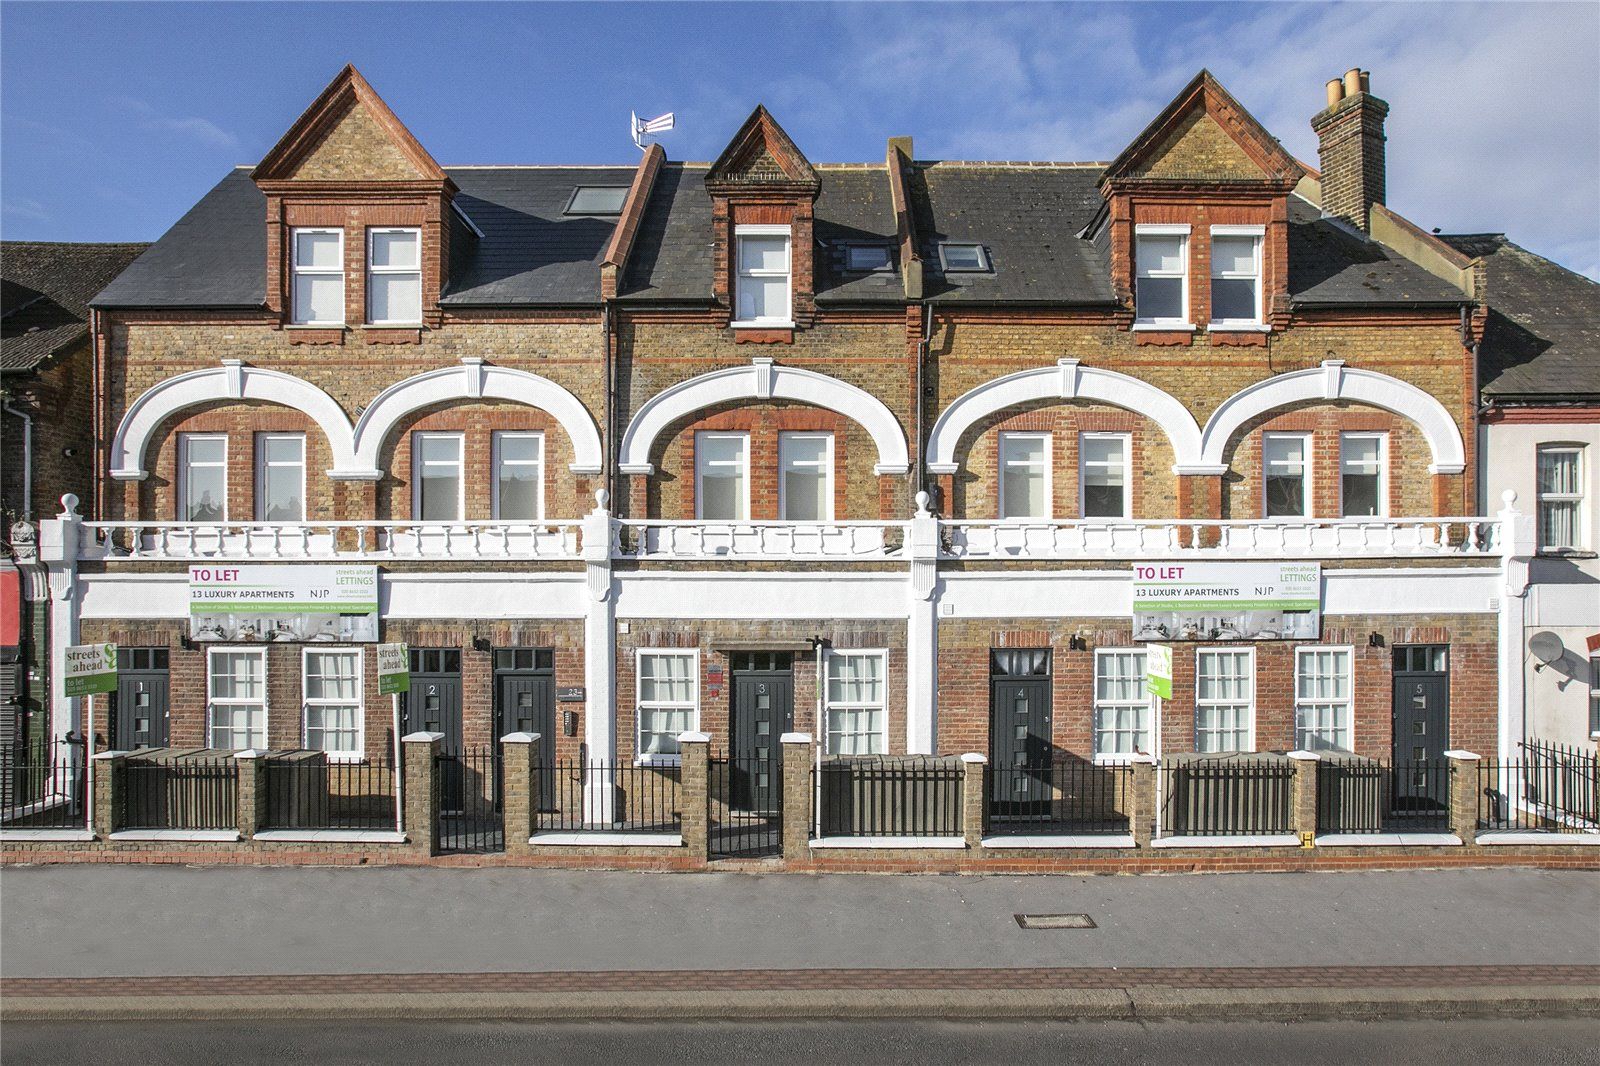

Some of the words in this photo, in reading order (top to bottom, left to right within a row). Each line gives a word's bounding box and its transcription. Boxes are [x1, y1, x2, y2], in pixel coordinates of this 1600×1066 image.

[192, 569, 211, 582] TO
[215, 569, 239, 582] LET
[1137, 567, 1155, 580] TO
[1160, 567, 1184, 579] LET
[1280, 574, 1317, 582] LETTINGS
[336, 577, 374, 585] LETTINGS
[204, 590, 237, 598] LUXURY
[239, 590, 295, 598] APARTMENTS
[310, 589, 330, 598] NJP
[1136, 589, 1146, 597] 13
[1149, 588, 1182, 597] LUXURY
[1184, 588, 1239, 597] APARTMENTS
[1255, 586, 1274, 595] NJP
[67, 650, 100, 661] streets
[380, 649, 399, 658] streets
[73, 660, 103, 672] ahead
[383, 659, 401, 670] ahead
[139, 682, 143, 691] 1
[429, 685, 436, 695] 2
[759, 683, 766, 693] 3
[1416, 683, 1423, 694] 5
[1017, 688, 1024, 698] 4
[1303, 833, 1312, 846] H
